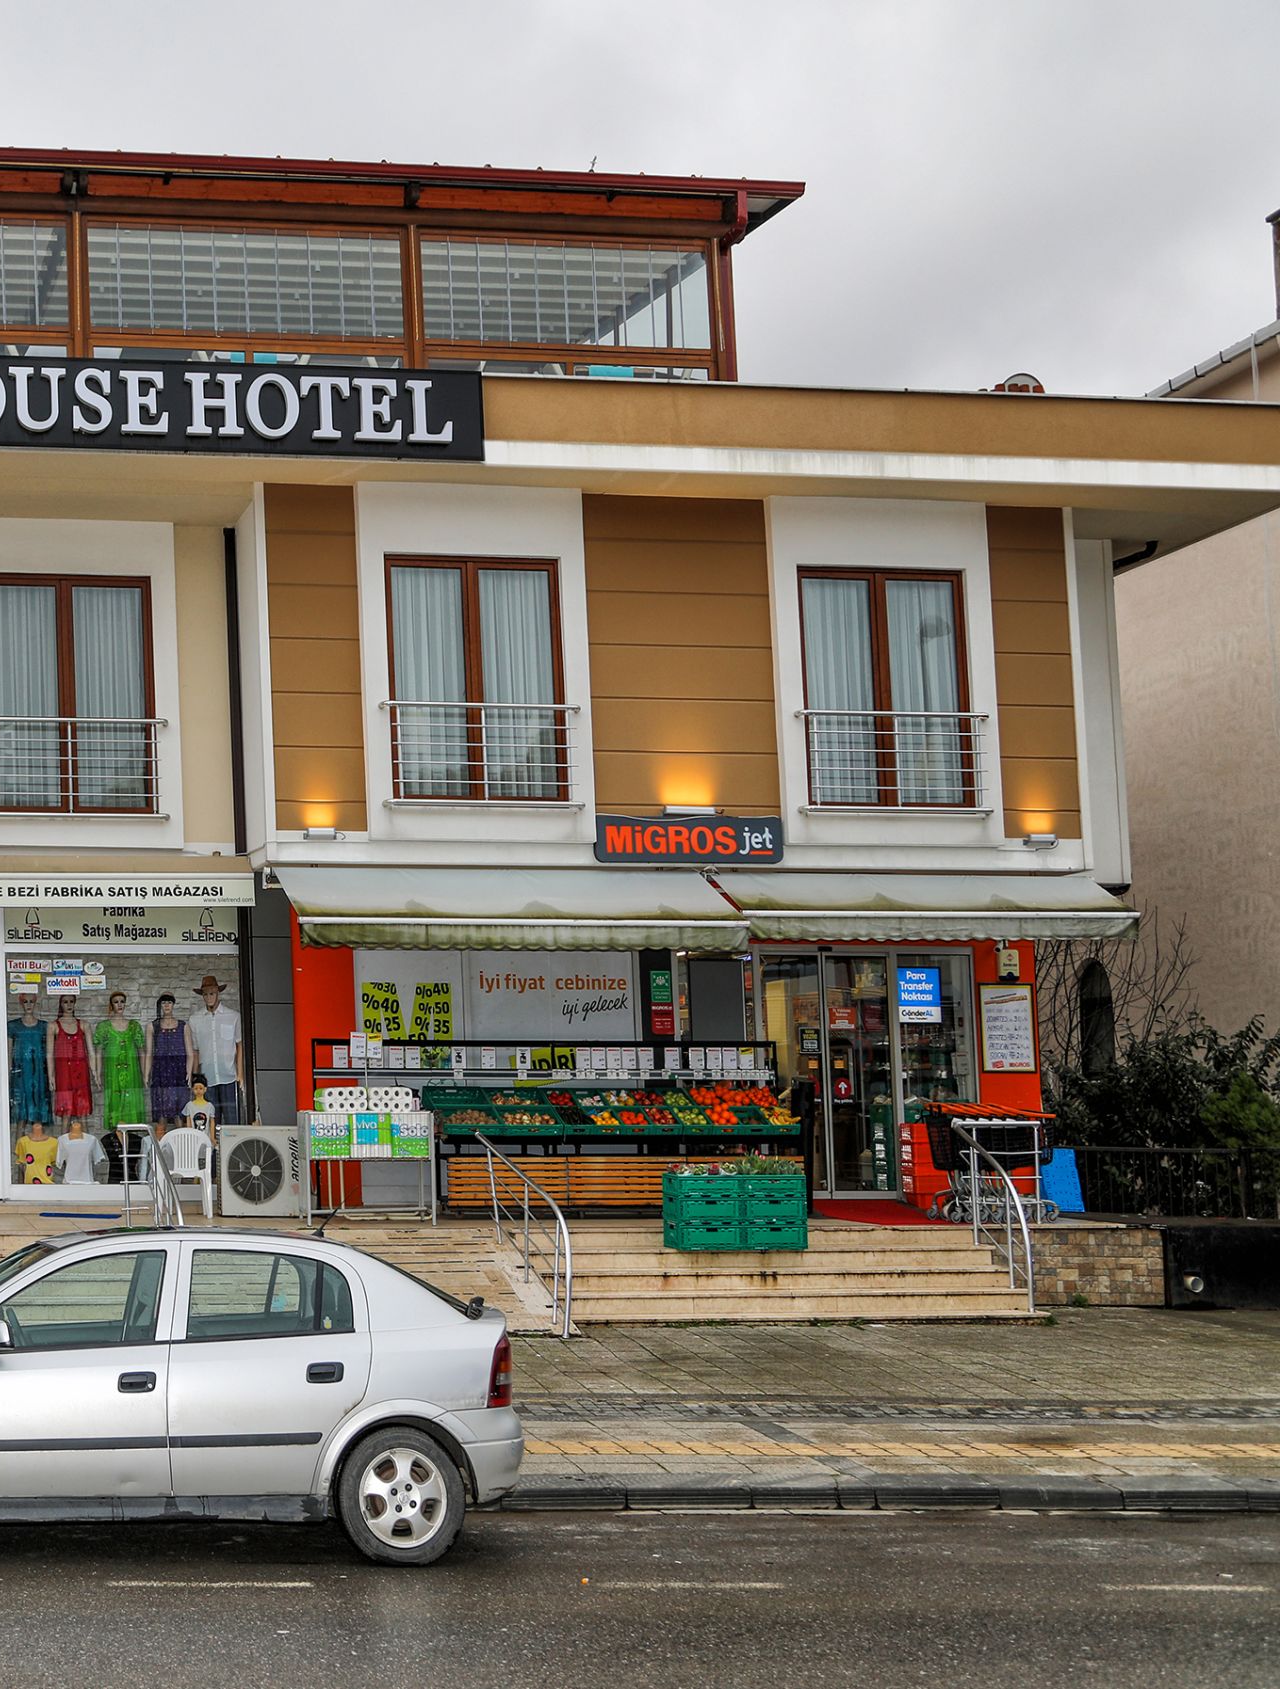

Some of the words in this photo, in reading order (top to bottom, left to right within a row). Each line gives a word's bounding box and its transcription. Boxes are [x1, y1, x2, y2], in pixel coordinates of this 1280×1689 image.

[183, 371, 454, 445] HOTEL
[739, 826, 773, 856] jet
[7, 884, 39, 897] BEZİ
[44, 884, 104, 898] FABRİKA
[108, 886, 148, 899] SATIŞ
[152, 884, 223, 897] MAĞAZASI
[82, 923, 111, 940] Satış
[114, 923, 167, 941] Mağazası
[8, 960, 28, 969] Tatil
[479, 970, 500, 993] İyi
[504, 973, 545, 994] fiyat
[555, 974, 627, 991] cebinize
[905, 970, 926, 980] Para
[415, 982, 450, 999] %40
[899, 981, 934, 991] Transfer
[361, 993, 400, 1014] %40
[901, 991, 933, 1001] Noktası
[418, 1001, 450, 1016] %50
[562, 999, 580, 1025] iyi
[582, 993, 629, 1022] gelecek
[363, 1016, 401, 1034] %25
[315, 1124, 346, 1138] Solo
[356, 1120, 378, 1129] viva
[400, 1123, 429, 1138] Solo
